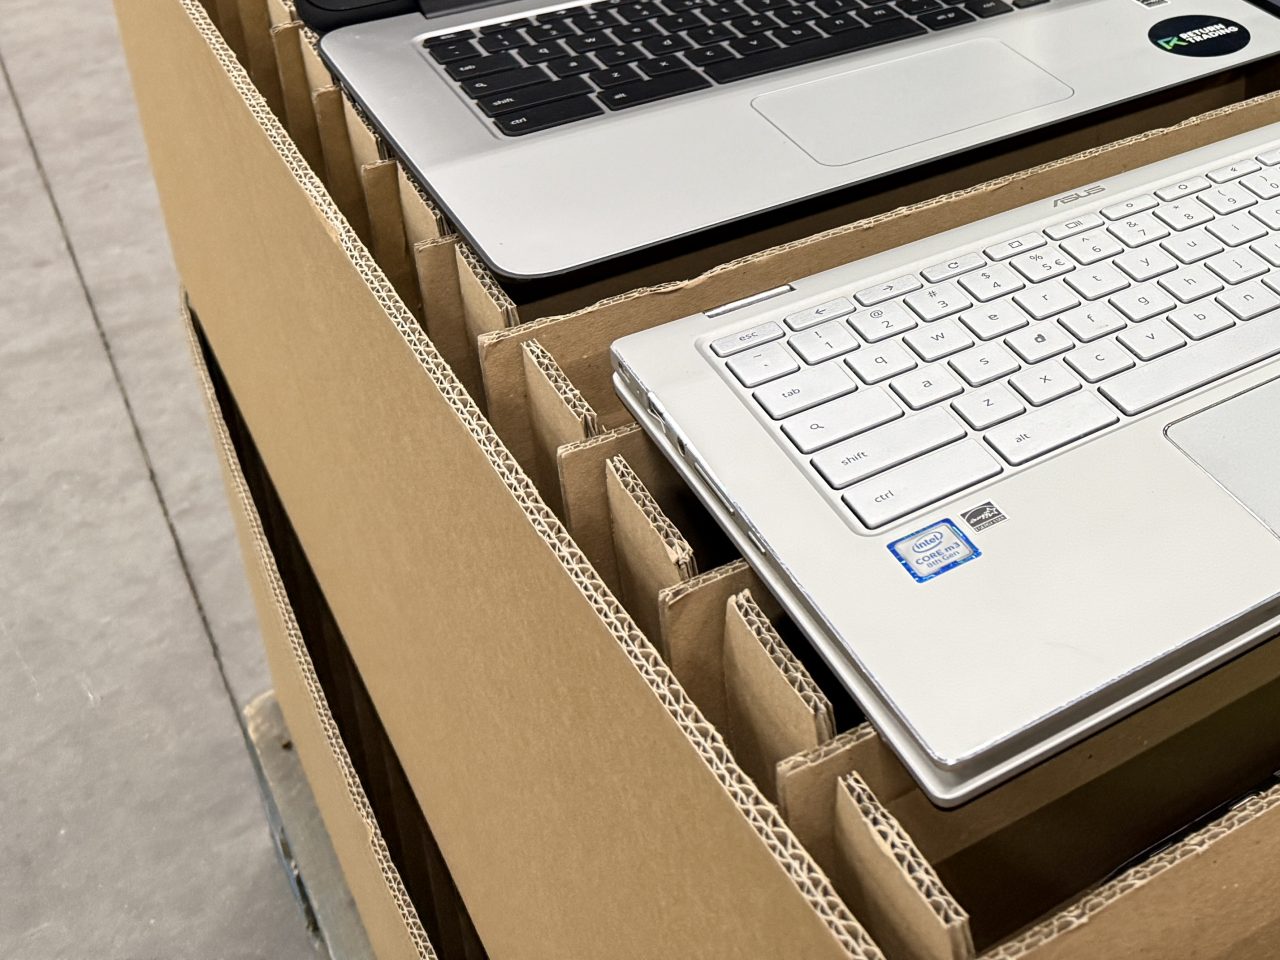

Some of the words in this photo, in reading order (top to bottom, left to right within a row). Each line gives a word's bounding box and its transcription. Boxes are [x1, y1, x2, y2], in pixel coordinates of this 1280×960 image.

[1179, 23, 1226, 40] RETURN
[1185, 26, 1239, 44] TRADING
[1053, 185, 1106, 208] ASUS
[1140, 258, 1150, 266] y
[1184, 277, 1197, 285] h
[1138, 296, 1150, 305] g
[1243, 293, 1254, 302] n
[937, 300, 949, 308] 3
[870, 310, 884, 319] @
[1193, 313, 1206, 321] b
[881, 321, 894, 329] 2
[739, 331, 759, 341] esc
[930, 332, 945, 341] w
[875, 356, 888, 365] q
[979, 357, 990, 365] s
[1039, 375, 1051, 383] x
[922, 380, 933, 388] a
[782, 388, 800, 398] tab
[983, 398, 994, 407] z
[1016, 433, 1031, 443] alt
[841, 451, 868, 466] shift
[874, 490, 895, 503] ctrl
[914, 533, 940, 551] intel
[915, 549, 944, 565] CORE
[944, 542, 961, 553] m3
[941, 551, 960, 562] Gen
